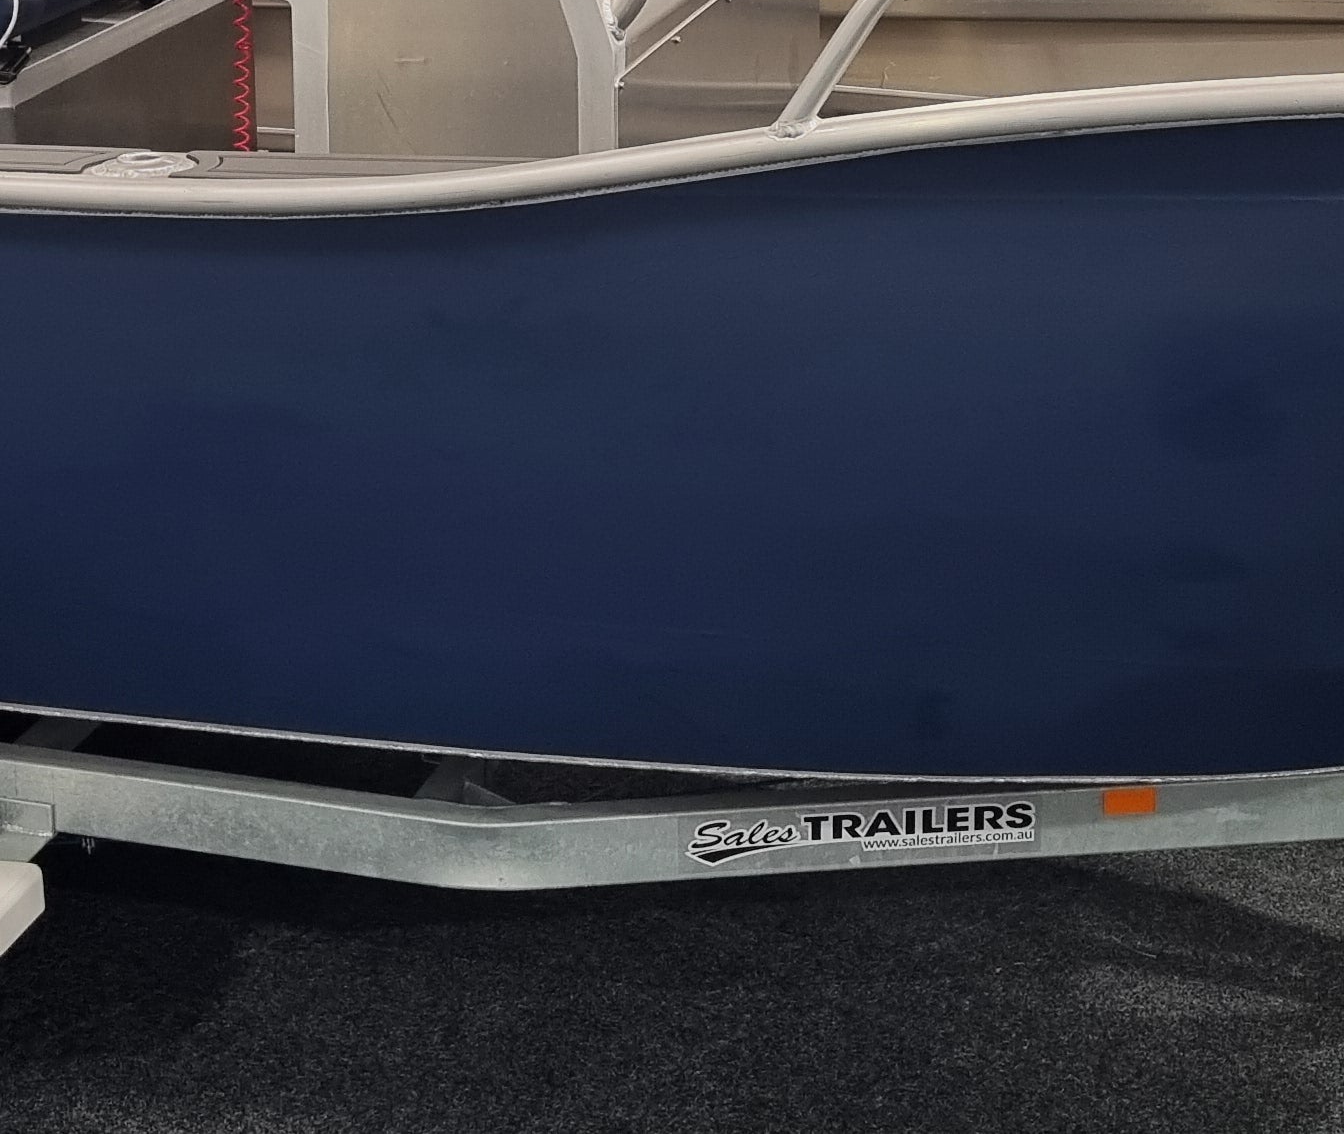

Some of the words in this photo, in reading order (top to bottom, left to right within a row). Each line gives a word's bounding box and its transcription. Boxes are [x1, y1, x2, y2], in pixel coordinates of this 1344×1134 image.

[690, 819, 797, 850] Sales
[803, 803, 1034, 841] TRAILERS
[862, 829, 1034, 851] www.salestrailers.com.au
